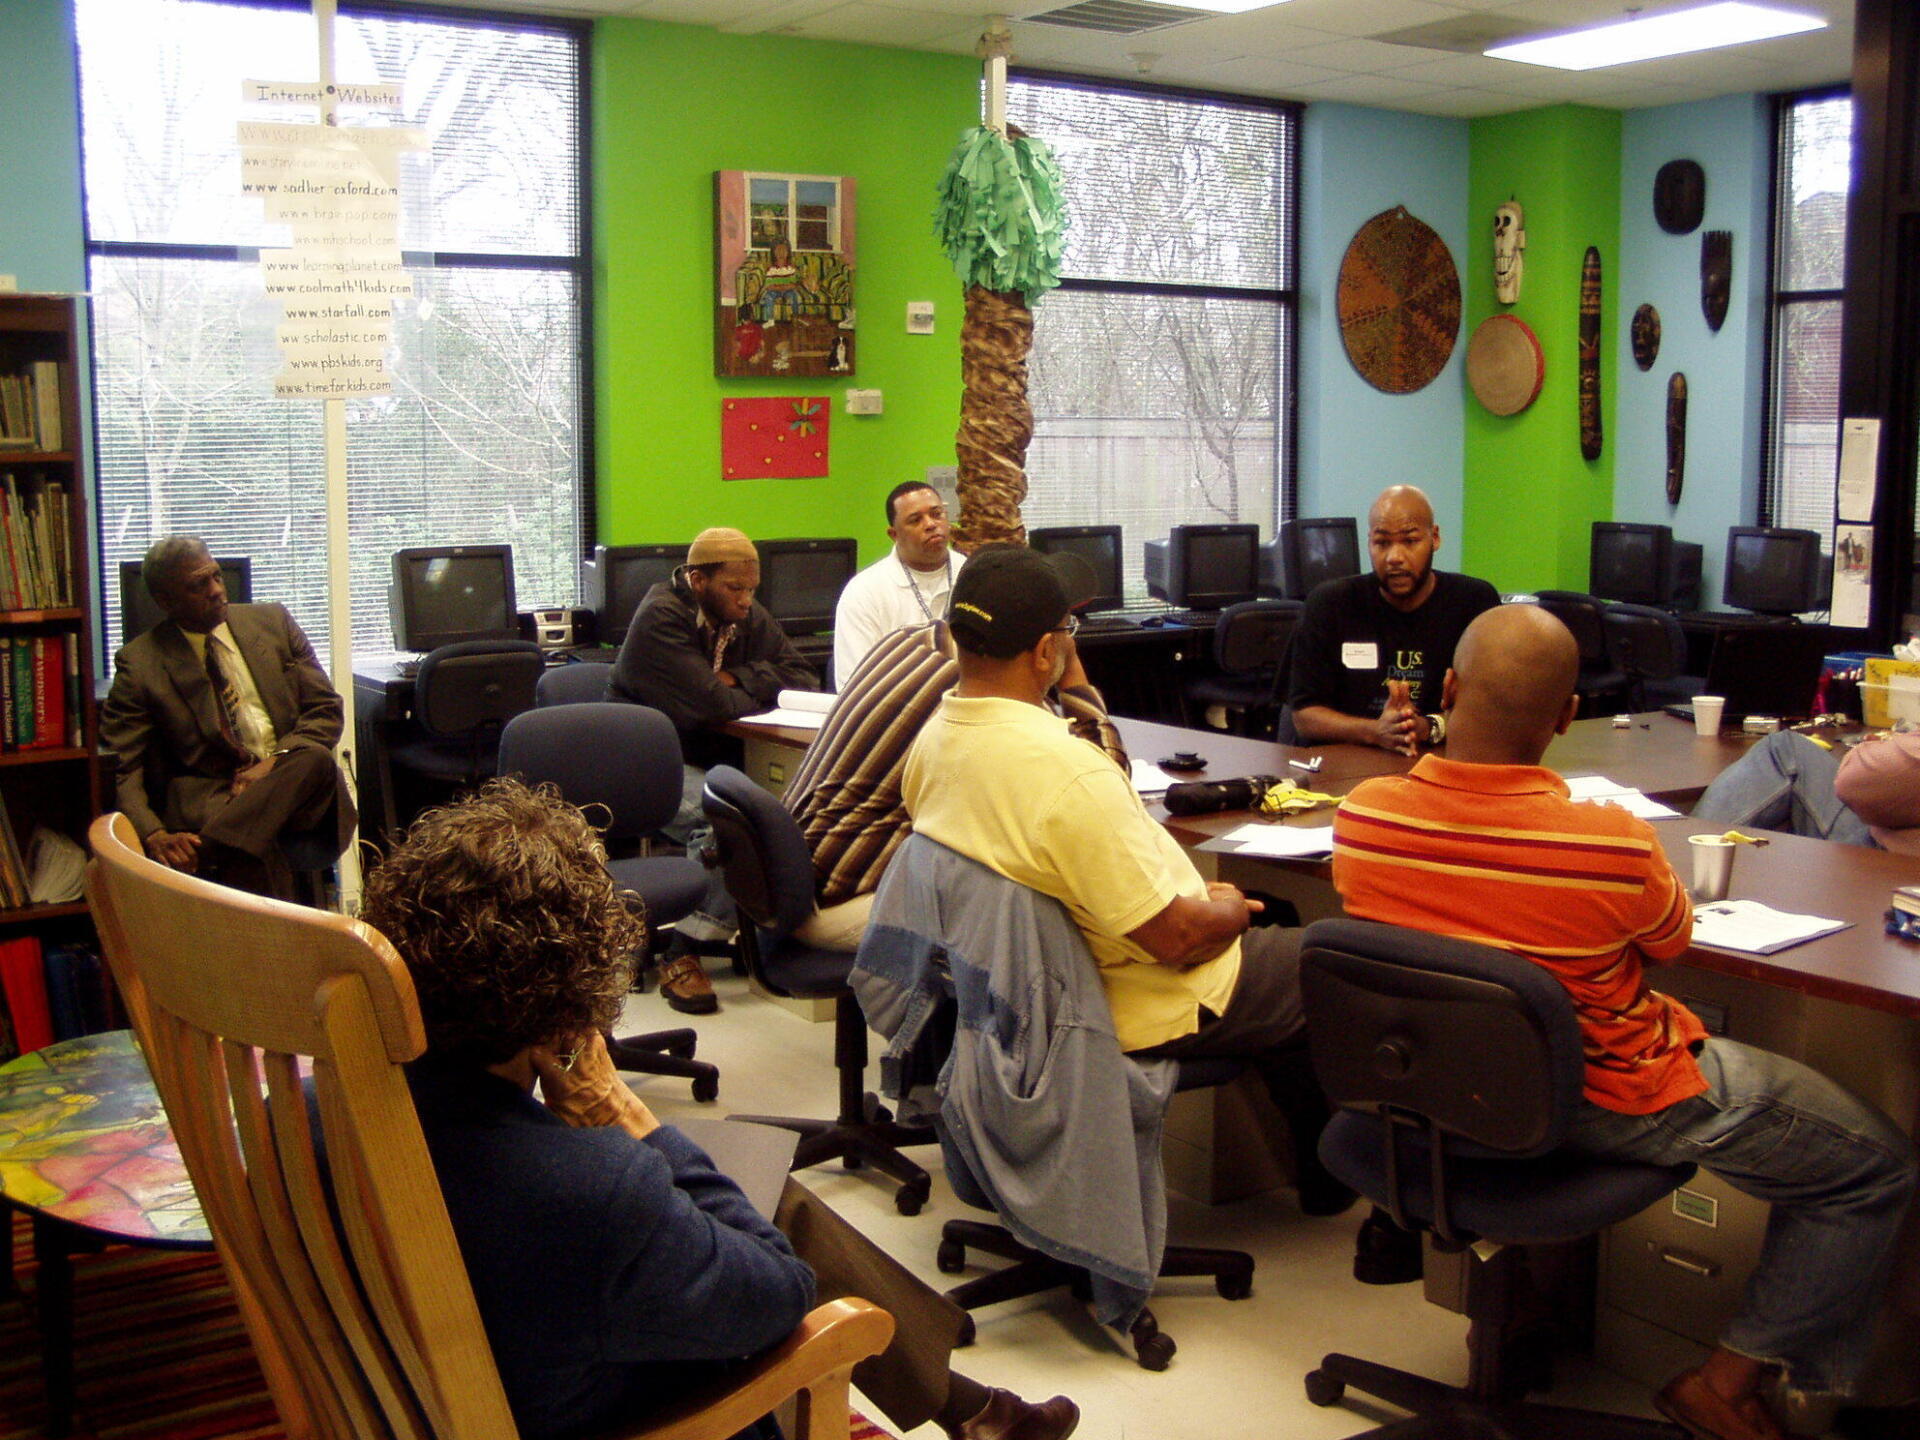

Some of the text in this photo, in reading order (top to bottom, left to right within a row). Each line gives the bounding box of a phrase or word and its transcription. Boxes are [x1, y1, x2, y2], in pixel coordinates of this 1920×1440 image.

[256, 86, 402, 104] Internet Websites
[286, 304, 391, 318] www.starfall.com
[291, 354, 383, 373] www.pbskids.org
[276, 377, 391, 393] www.timeforkids.com
